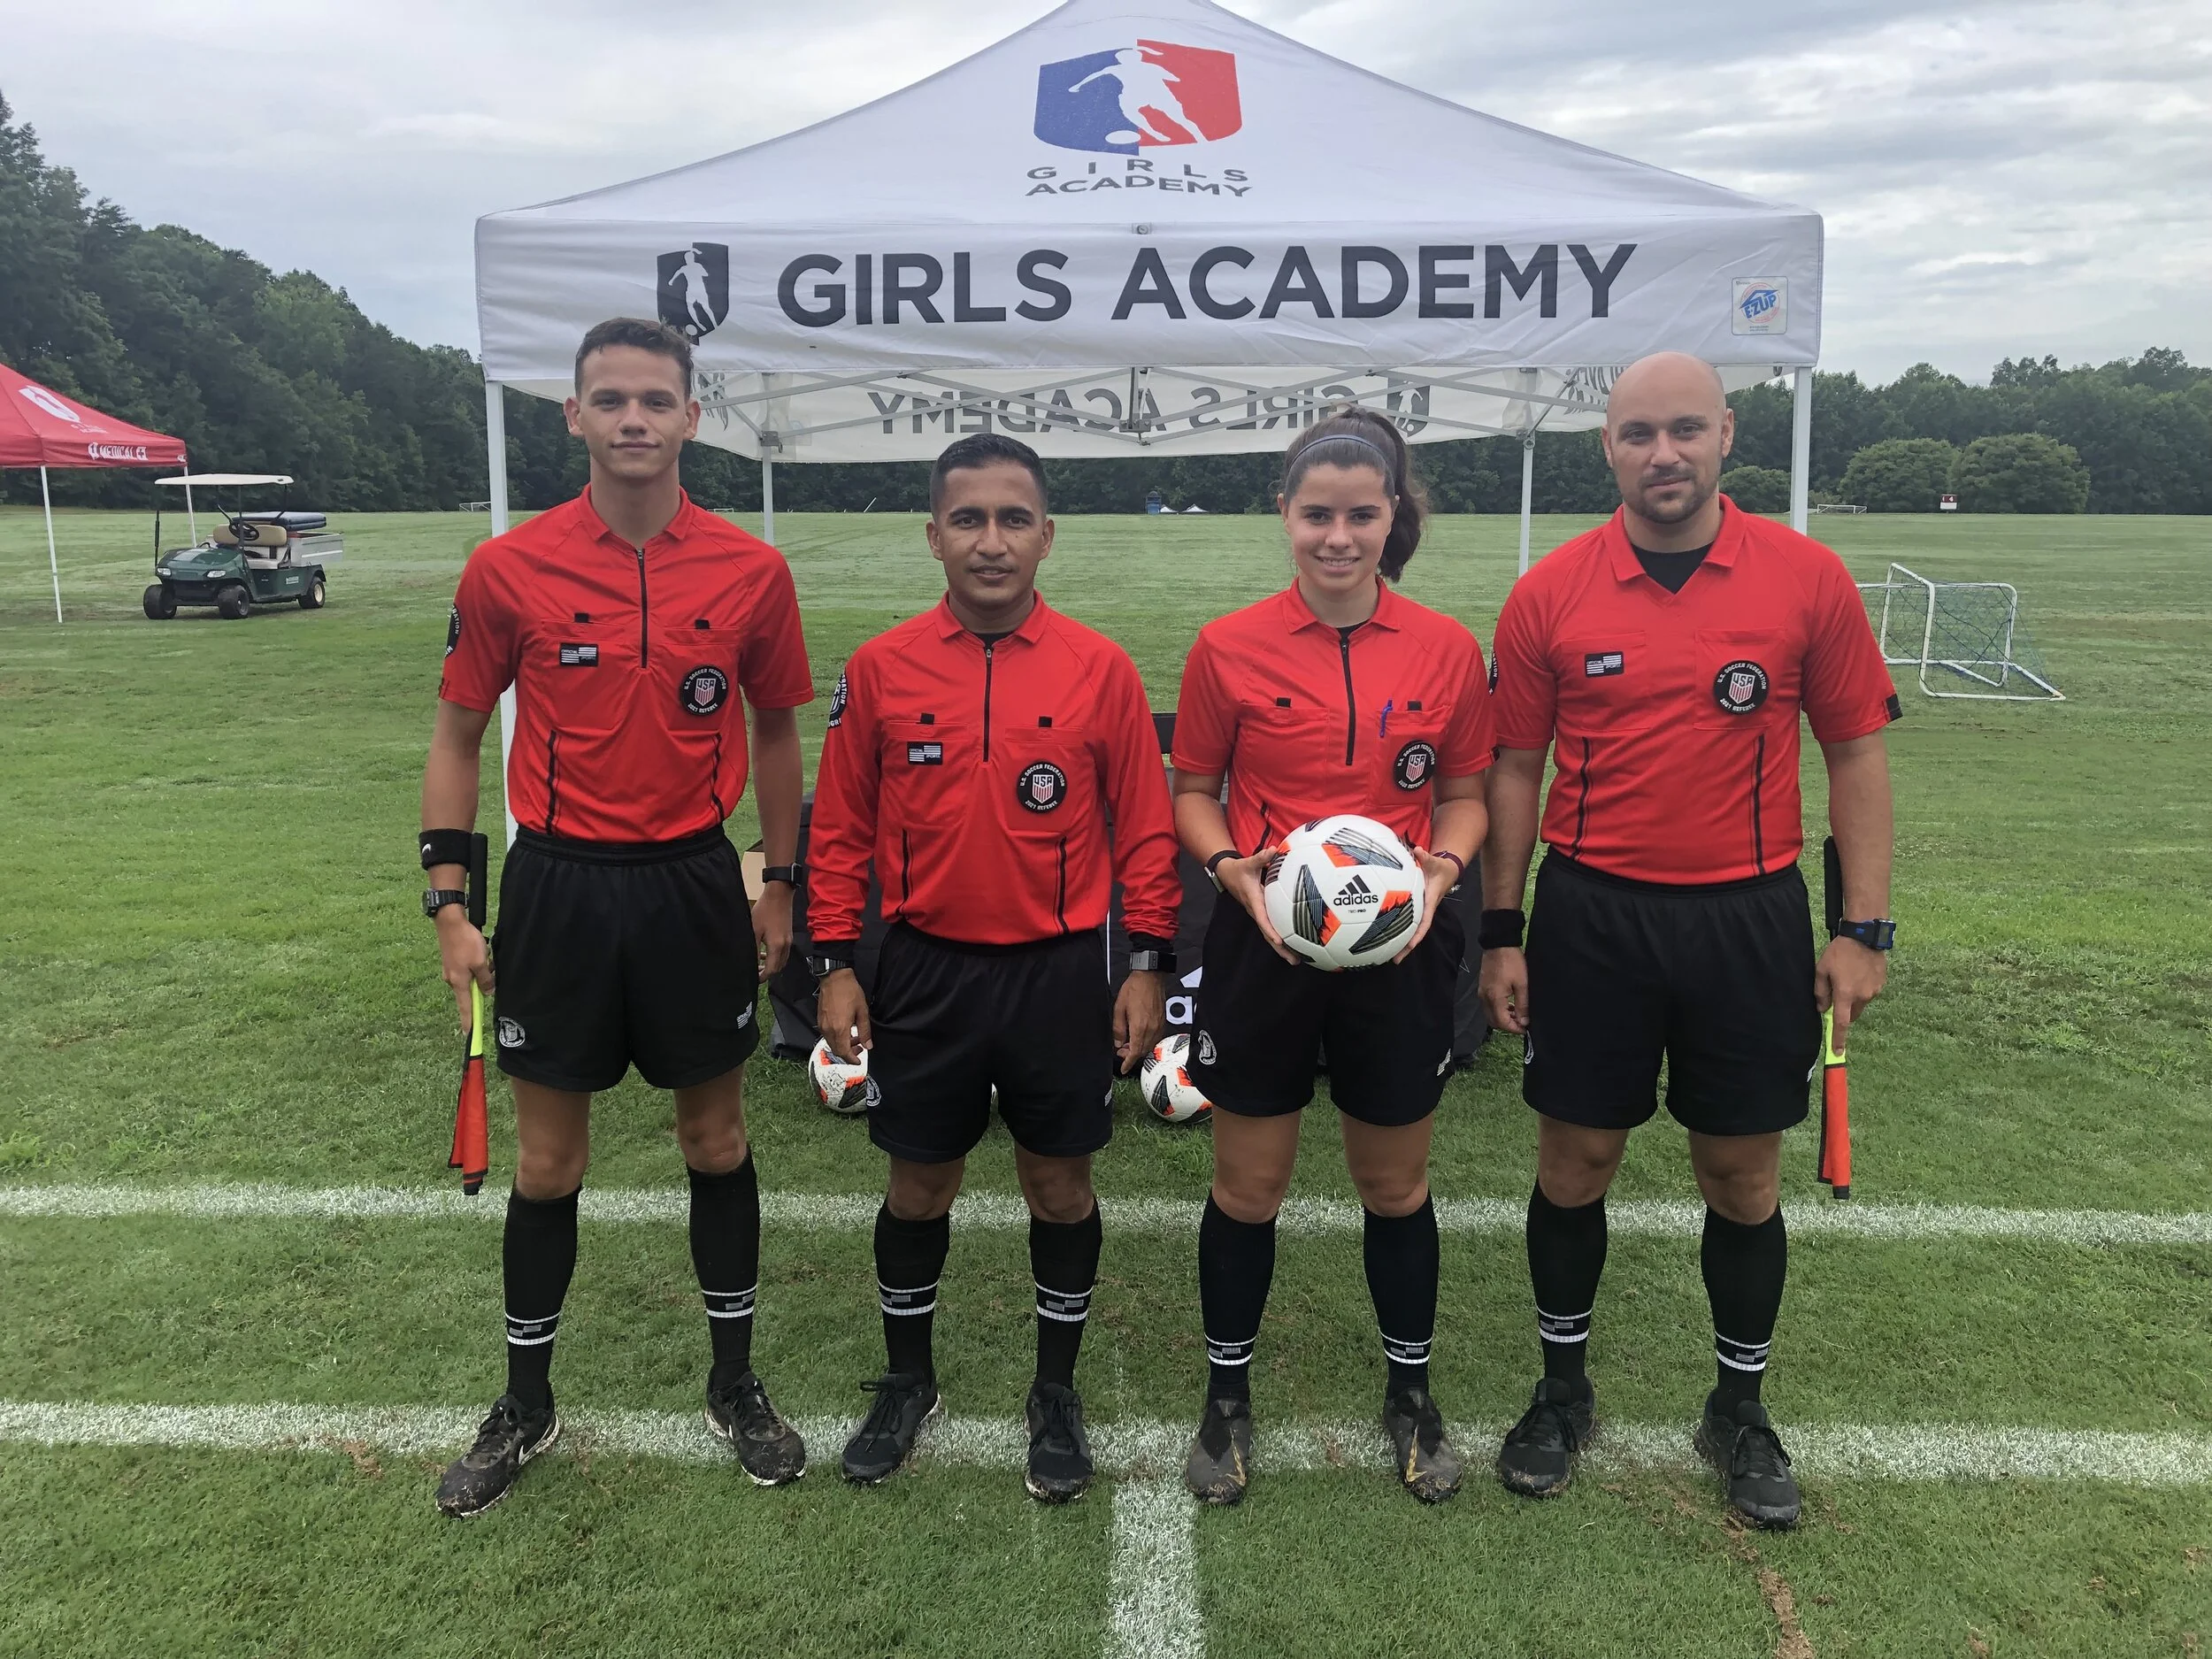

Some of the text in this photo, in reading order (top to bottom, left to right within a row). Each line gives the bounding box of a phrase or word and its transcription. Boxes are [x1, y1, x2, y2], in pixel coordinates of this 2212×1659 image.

[1026, 158, 1248, 182] GIRLS
[1025, 175, 1252, 197] ACADEMY
[778, 244, 1638, 327] GIRLS ACADEMY
[99, 445, 137, 460] MEDICAL
[697, 680, 715, 690] USA
[1733, 673, 1754, 687] USA
[1410, 756, 1425, 766] USA
[1025, 764, 1043, 777] SOCCER
[1044, 764, 1065, 787] FEDERATION
[1033, 776, 1053, 787] USA
[1025, 800, 1036, 810] 2021
[1333, 894, 1379, 906] adidas
